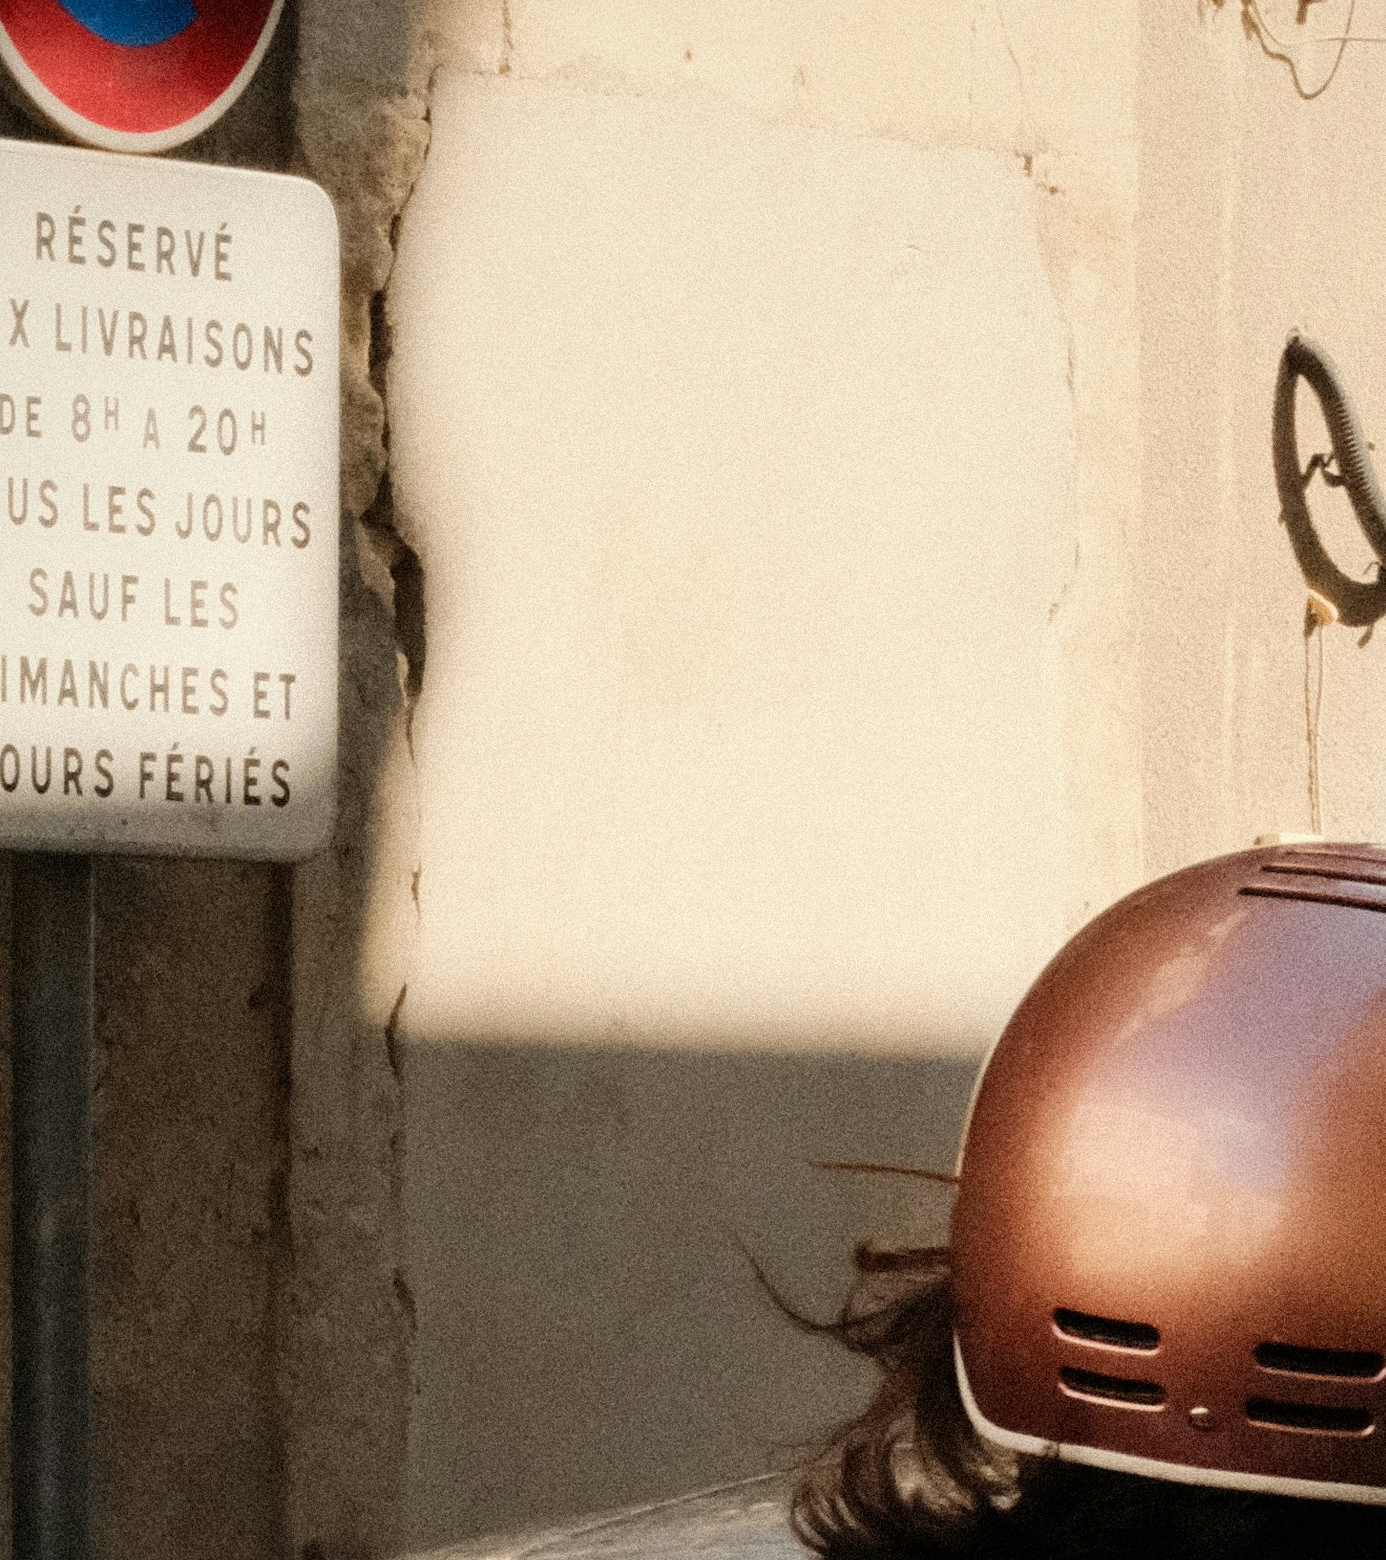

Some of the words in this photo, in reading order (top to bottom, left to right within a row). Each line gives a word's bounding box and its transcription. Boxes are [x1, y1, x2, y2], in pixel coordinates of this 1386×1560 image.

[36, 205, 233, 281] RÉSERVÉ
[54, 302, 314, 378] LIVRAISONS
[142, 407, 161, 450] A
[82, 483, 156, 537] LES
[175, 491, 312, 550] JOURS
[27, 567, 140, 622] SAUF
[164, 576, 239, 631] LES
[252, 671, 297, 721] ET
[139, 741, 292, 809] FÉRIÉS
